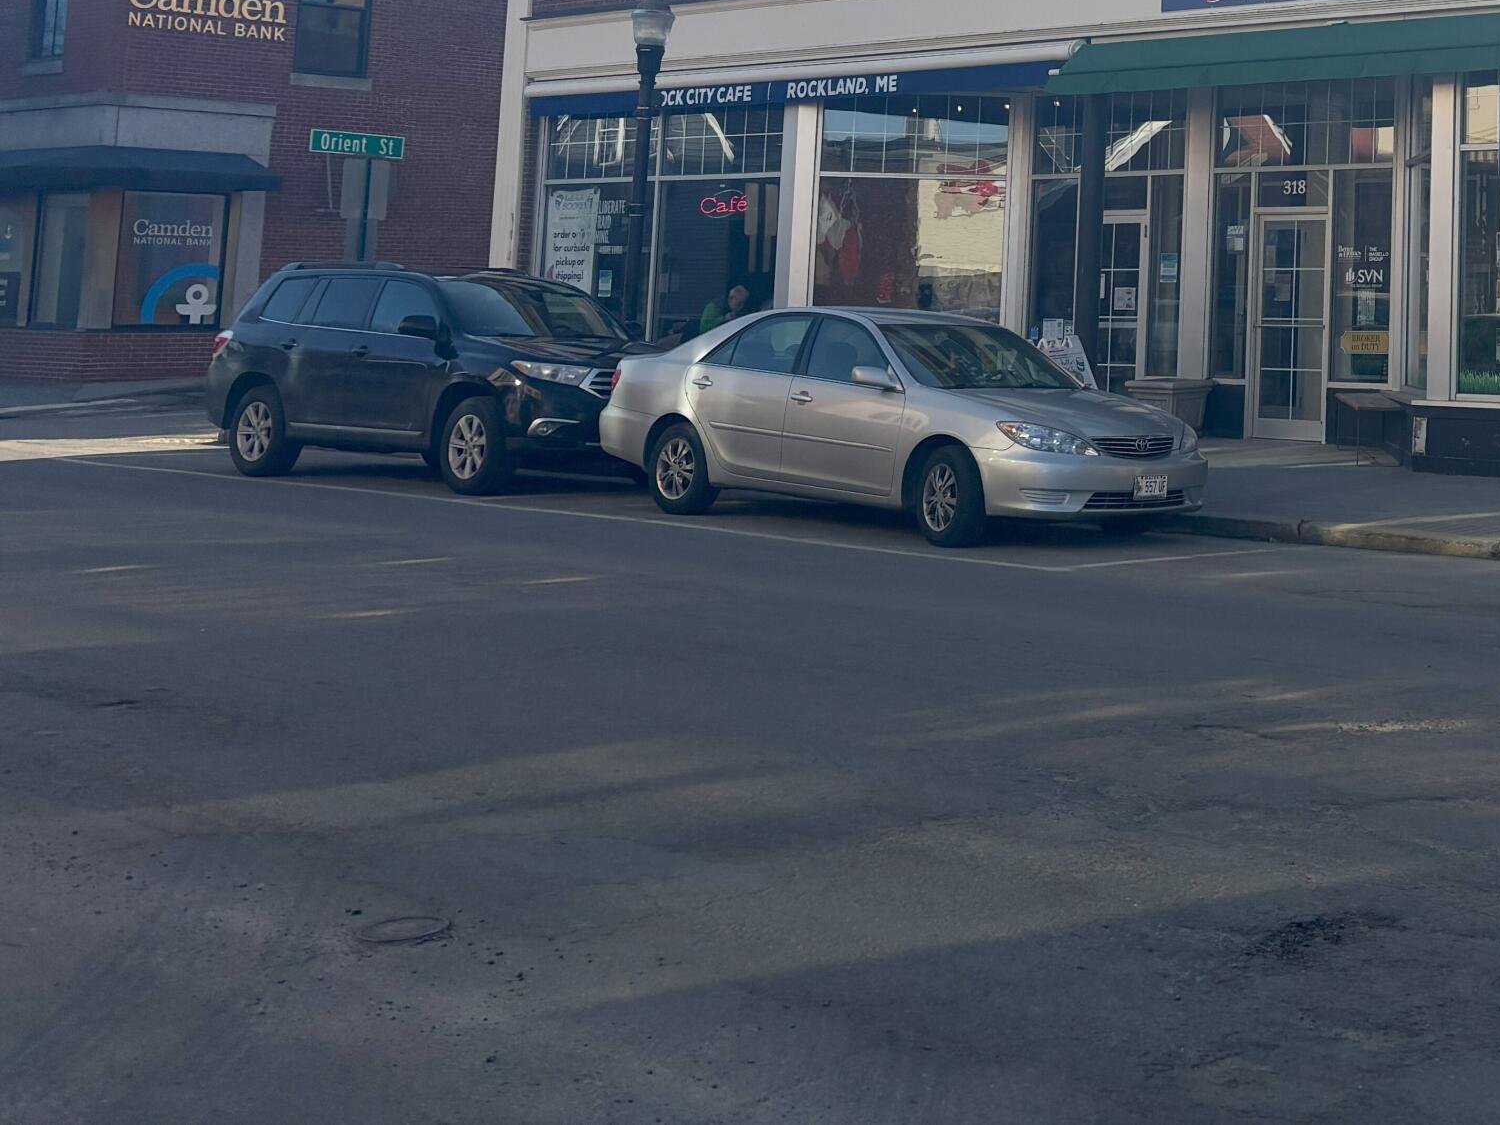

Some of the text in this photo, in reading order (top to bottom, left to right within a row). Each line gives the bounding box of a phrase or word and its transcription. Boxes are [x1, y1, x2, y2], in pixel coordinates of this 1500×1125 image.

[128, 11, 286, 42] NATIONAL BANK
[655, 75, 898, 107] OCK CITY CAFE ROCKLAND, ME
[320, 133, 394, 155] Orient St
[1283, 180, 1306, 195] 318
[700, 194, 749, 215] Café
[133, 219, 214, 237] Camden
[133, 236, 182, 246] NATIONAL
[555, 256, 577, 267] pickup
[1357, 269, 1383, 283] SVN
[1351, 334, 1381, 342] BROKER
[1361, 342, 1381, 352] DUTY
